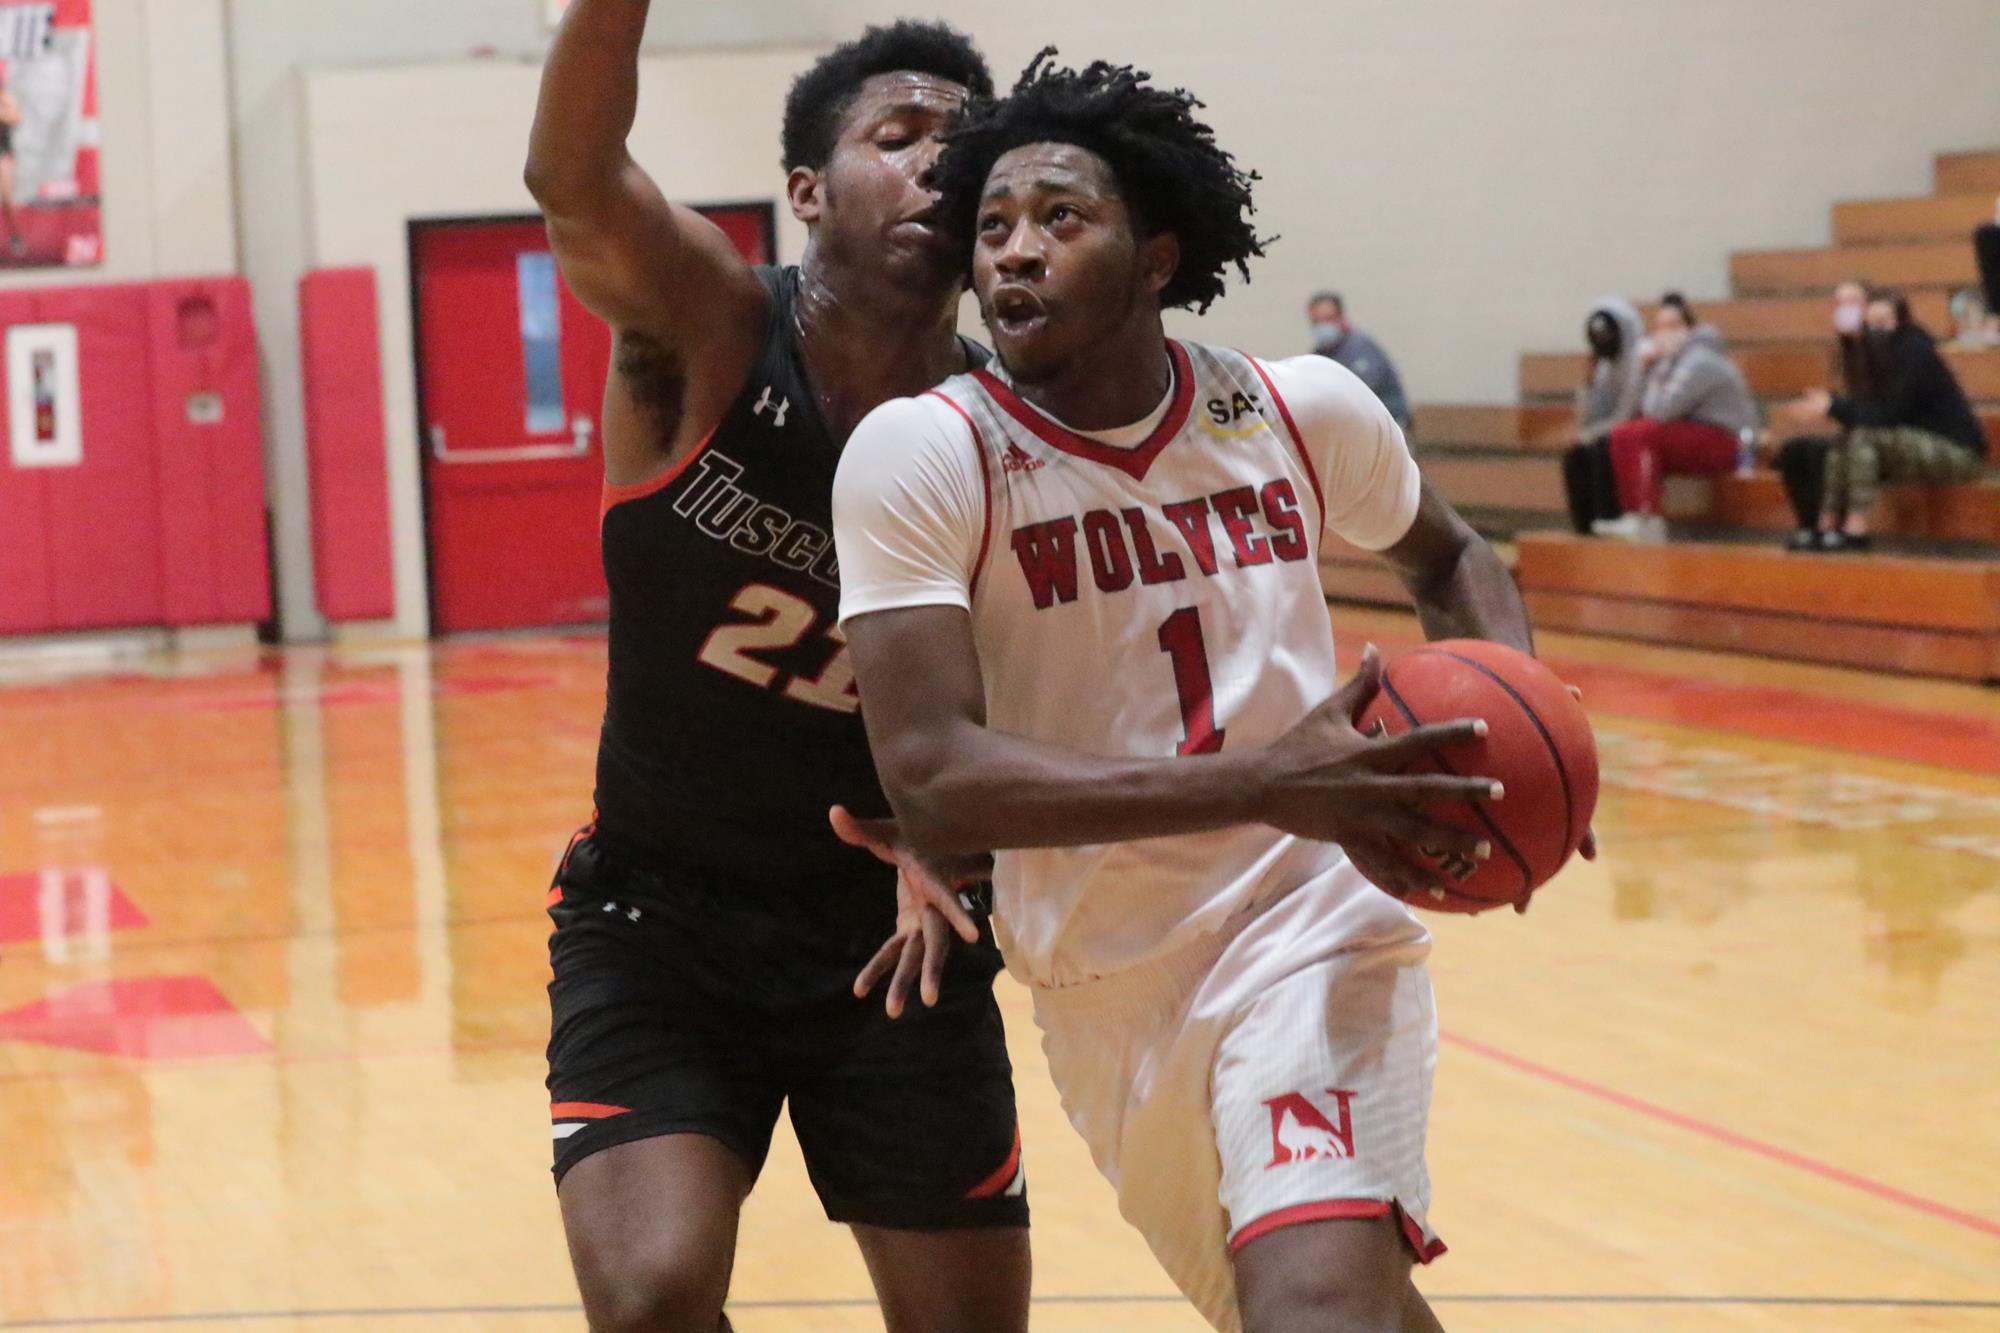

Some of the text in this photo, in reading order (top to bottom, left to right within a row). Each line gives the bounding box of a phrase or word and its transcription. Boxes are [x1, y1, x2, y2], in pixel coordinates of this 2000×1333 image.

[1010, 478, 1308, 610] WOLVES
[697, 583, 862, 714] 21
[1158, 605, 1226, 757] 1
[1261, 1087, 1359, 1171] N
